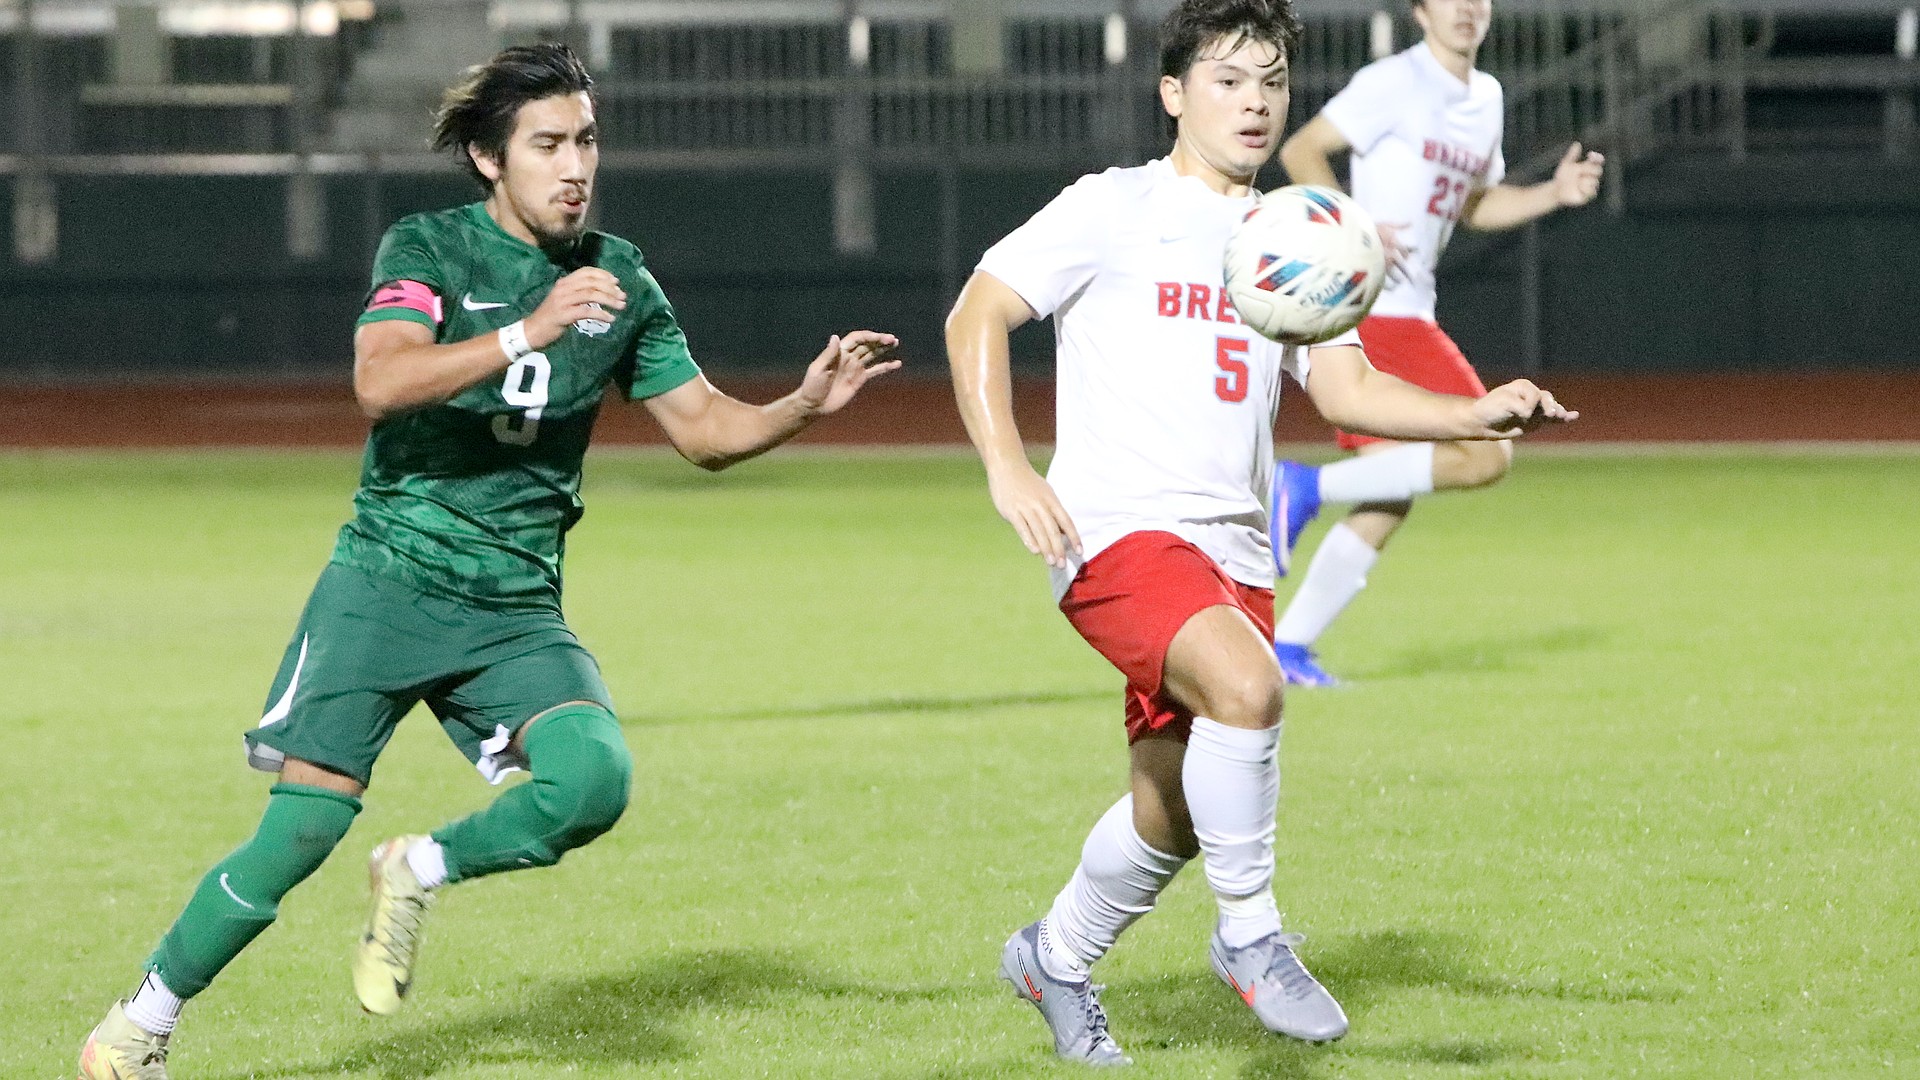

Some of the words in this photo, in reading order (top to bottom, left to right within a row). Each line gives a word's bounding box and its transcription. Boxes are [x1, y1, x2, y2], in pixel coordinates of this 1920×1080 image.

[1155, 282, 1248, 325] BRE
[491, 351, 551, 446] 9
[1214, 335, 1249, 404] 5
